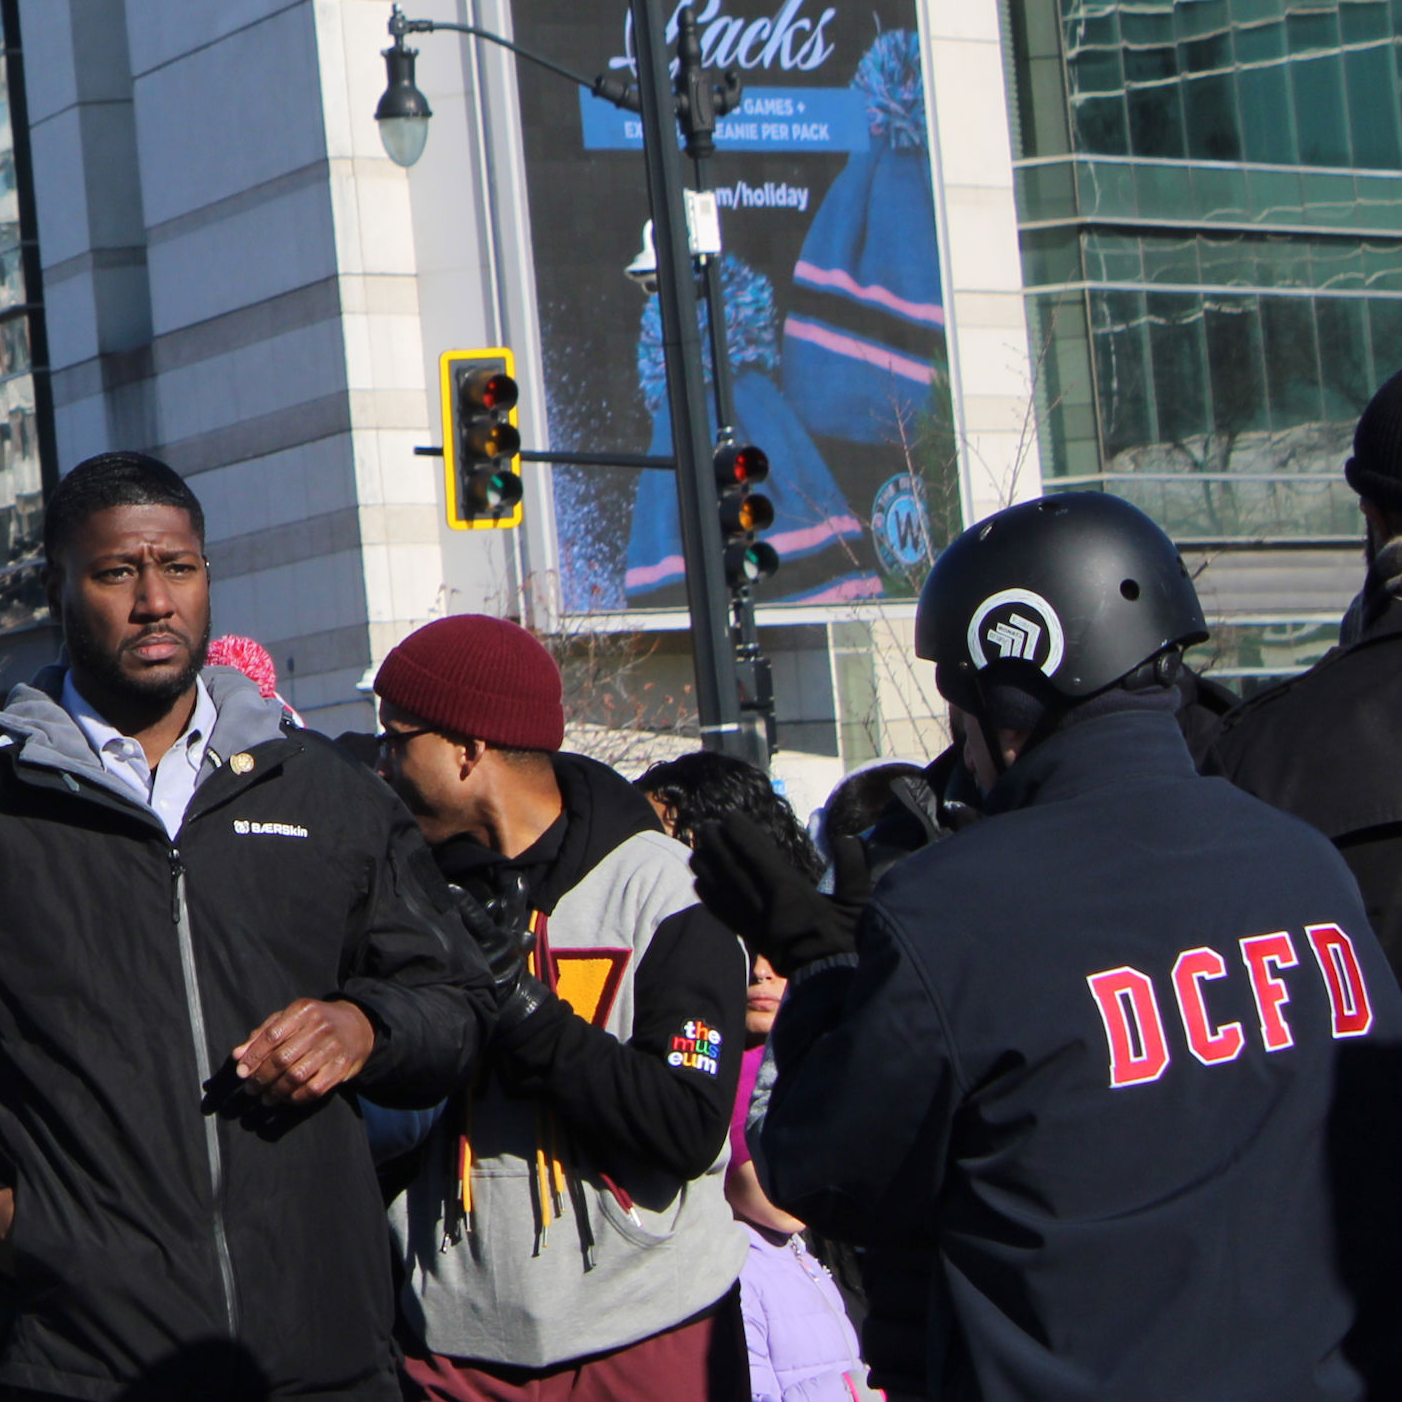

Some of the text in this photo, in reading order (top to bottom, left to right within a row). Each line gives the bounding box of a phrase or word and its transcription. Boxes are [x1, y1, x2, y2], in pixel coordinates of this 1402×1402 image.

[744, 98, 794, 116] GAMES
[711, 121, 830, 141] EANIE PER PACK
[713, 181, 809, 212] m/holiday
[1085, 922, 1374, 1089] DCFD
[683, 1020, 722, 1046] the
[672, 1035, 720, 1059] mus
[667, 1051, 717, 1075] eum
